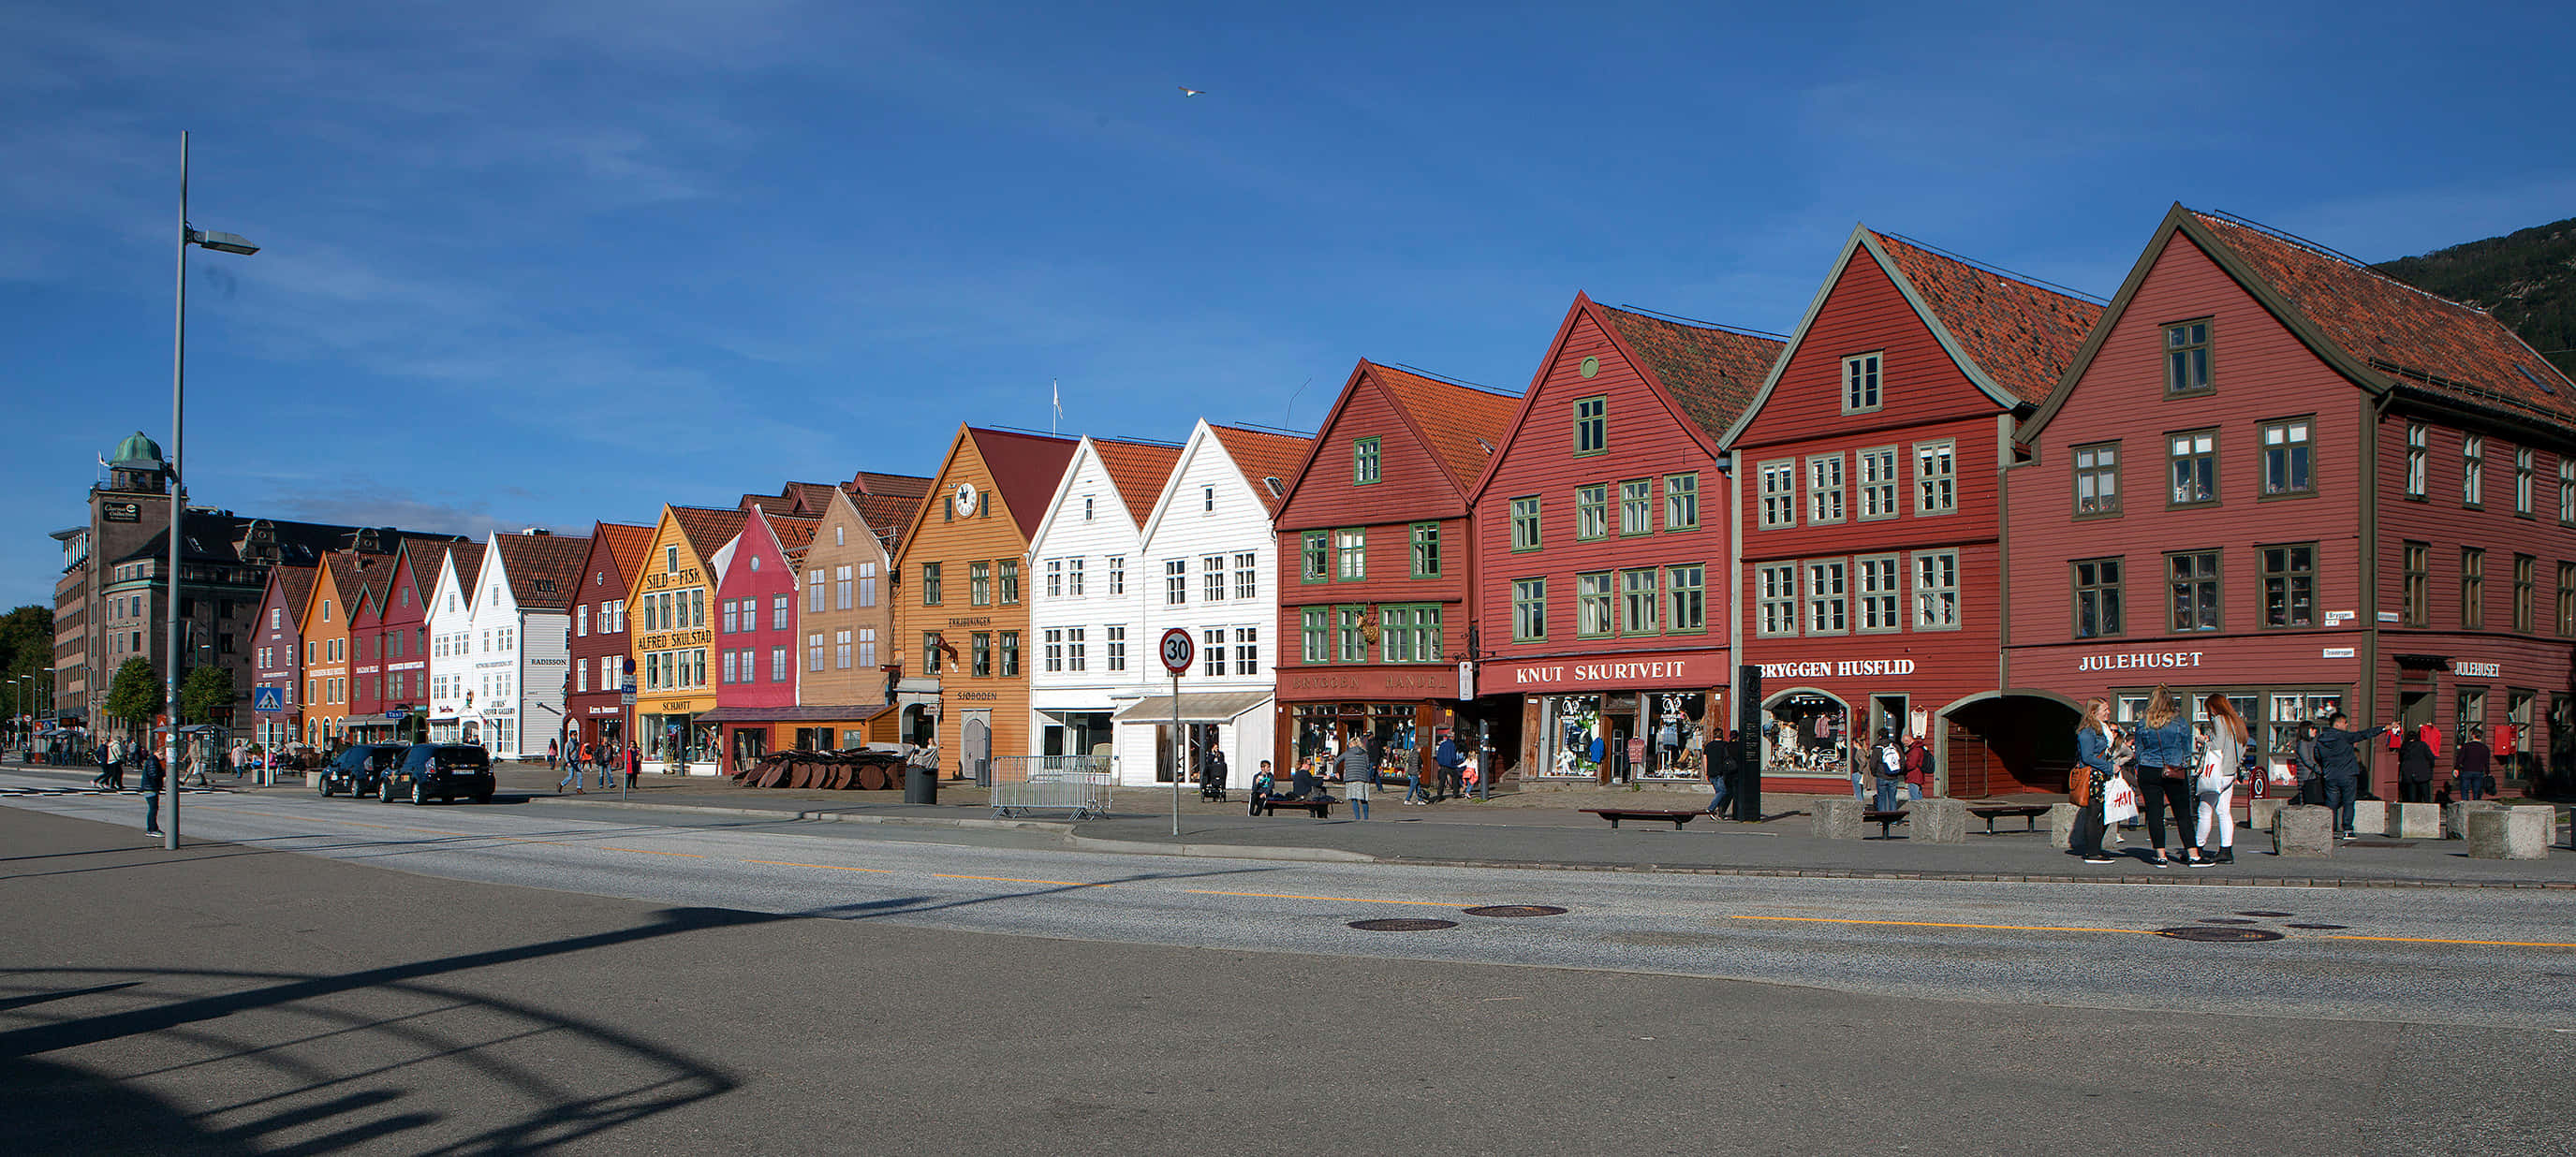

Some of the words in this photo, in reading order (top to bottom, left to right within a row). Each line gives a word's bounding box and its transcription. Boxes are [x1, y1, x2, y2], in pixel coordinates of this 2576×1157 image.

[647, 572, 669, 589] SILD
[679, 567, 701, 584] FISK
[638, 635, 667, 650] ALFRED
[671, 630, 712, 647] SKULSTAD
[1167, 639, 1188, 661] 30
[1837, 659, 1916, 676] HUSFLID
[2079, 652, 2203, 671] JULEHUSET
[2454, 661, 2500, 677] JULEHUSET
[1516, 666, 1564, 683] KNUT
[1574, 661, 1685, 681] SKURTVEIT
[1292, 675, 1360, 689] BRYGGEN
[1386, 675, 1447, 689] HANDEL
[957, 692, 997, 700] SJØBODEN
